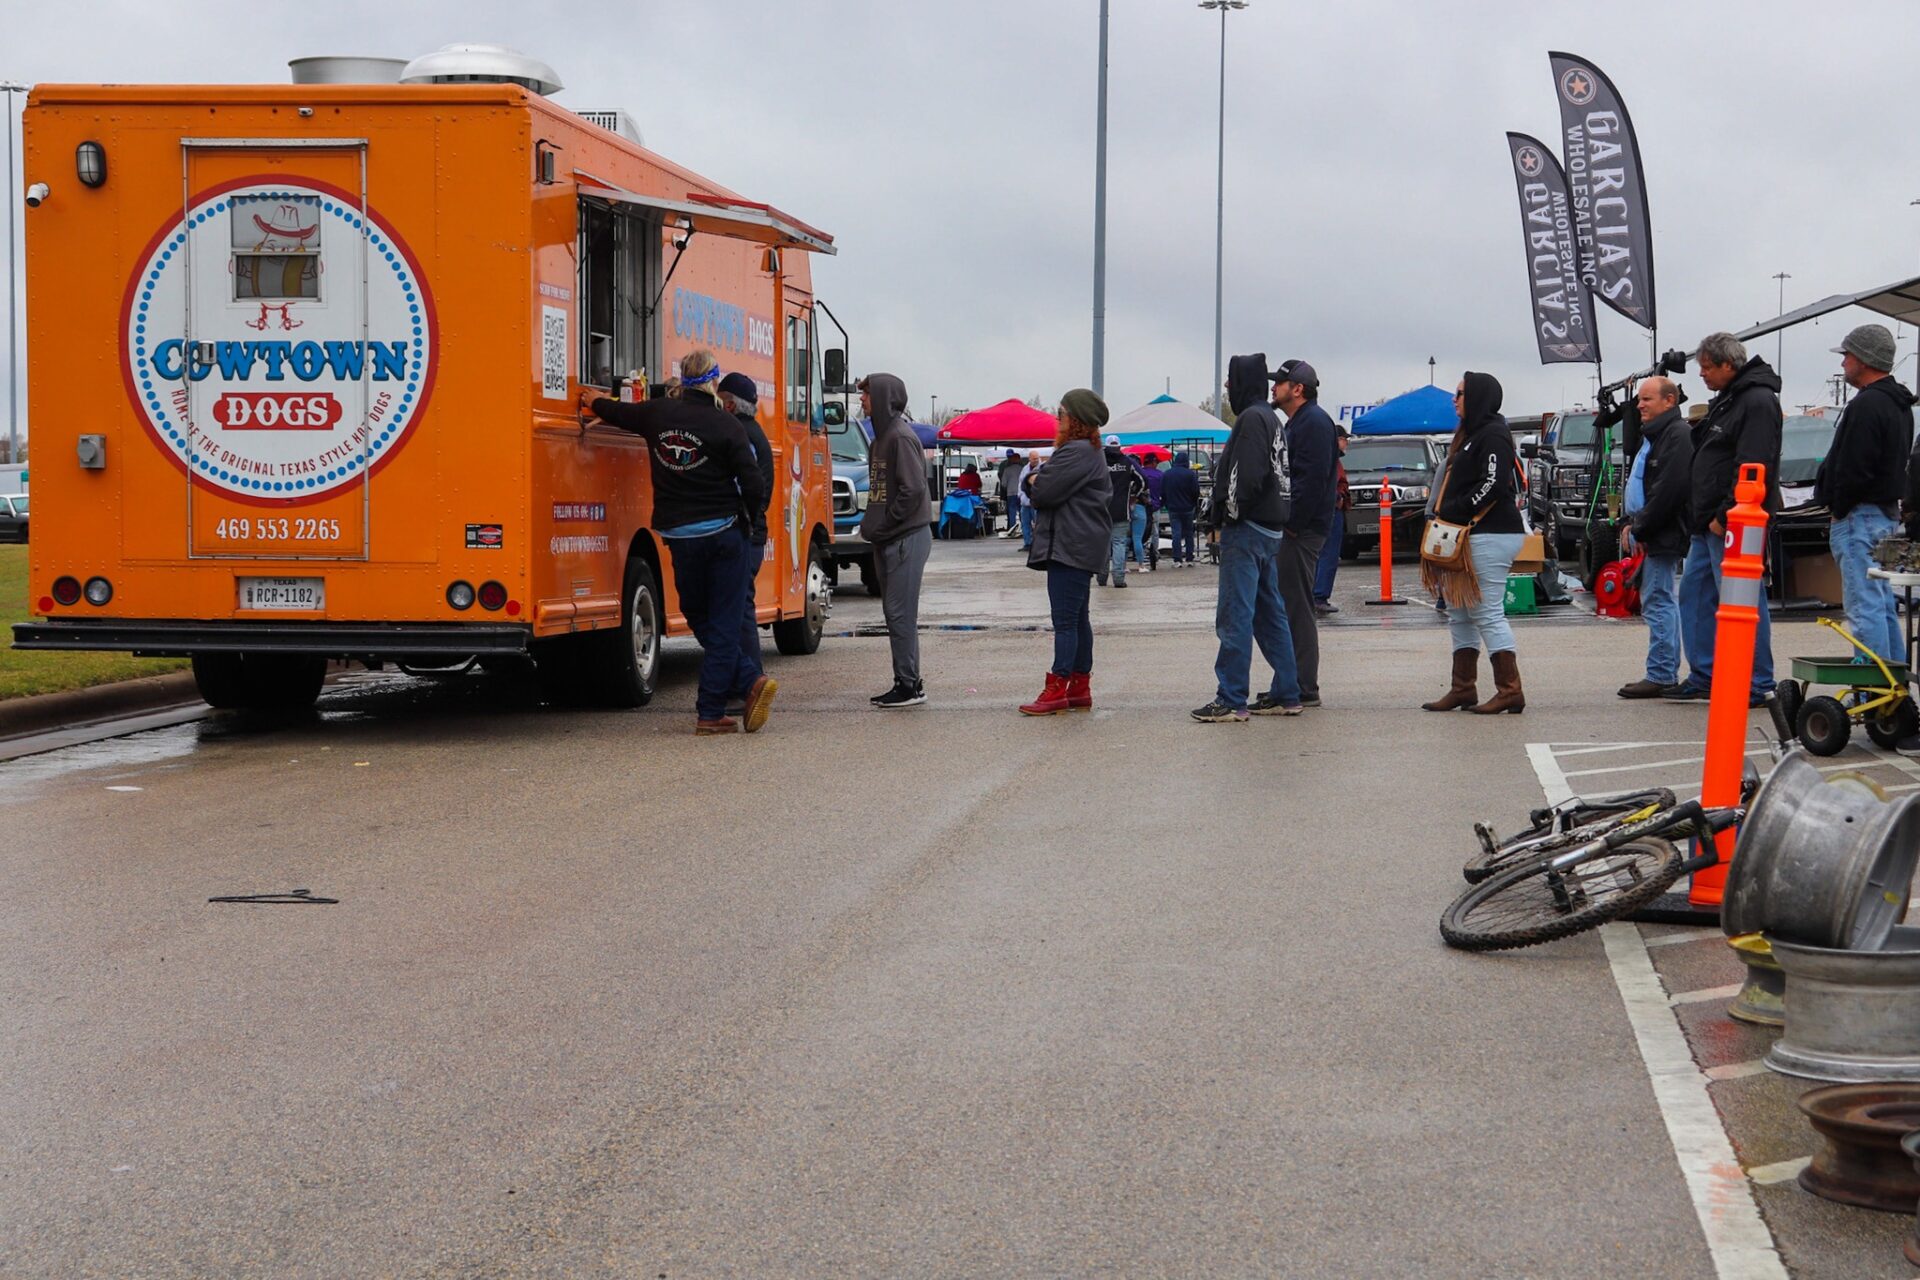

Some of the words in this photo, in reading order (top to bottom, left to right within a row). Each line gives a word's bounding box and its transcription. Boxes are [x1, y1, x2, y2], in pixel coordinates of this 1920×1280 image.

[1567, 124, 1593, 249] WHOLESALE
[1586, 110, 1633, 300] GARCIA'S
[673, 287, 745, 354] COWTOWN
[748, 316, 774, 357] DOGS
[150, 338, 408, 381] COWTOWN
[226, 397, 329, 426] DOGS
[171, 389, 189, 422] HOME
[188, 421, 200, 438] OF
[198, 435, 220, 457] THE
[220, 450, 275, 476] ORIGINAL
[280, 458, 317, 476] TEXAS
[319, 440, 354, 467] STYLE
[368, 391, 392, 422] DOGS
[658, 429, 678, 440] DOUBLE
[684, 431, 703, 446] RANCH
[216, 518, 250, 540] 469
[256, 518, 289, 540] 553
[295, 518, 340, 540] 2265
[553, 505, 572, 519] FOLLOW
[573, 505, 580, 519] US
[273, 578, 297, 586] TEXAS
